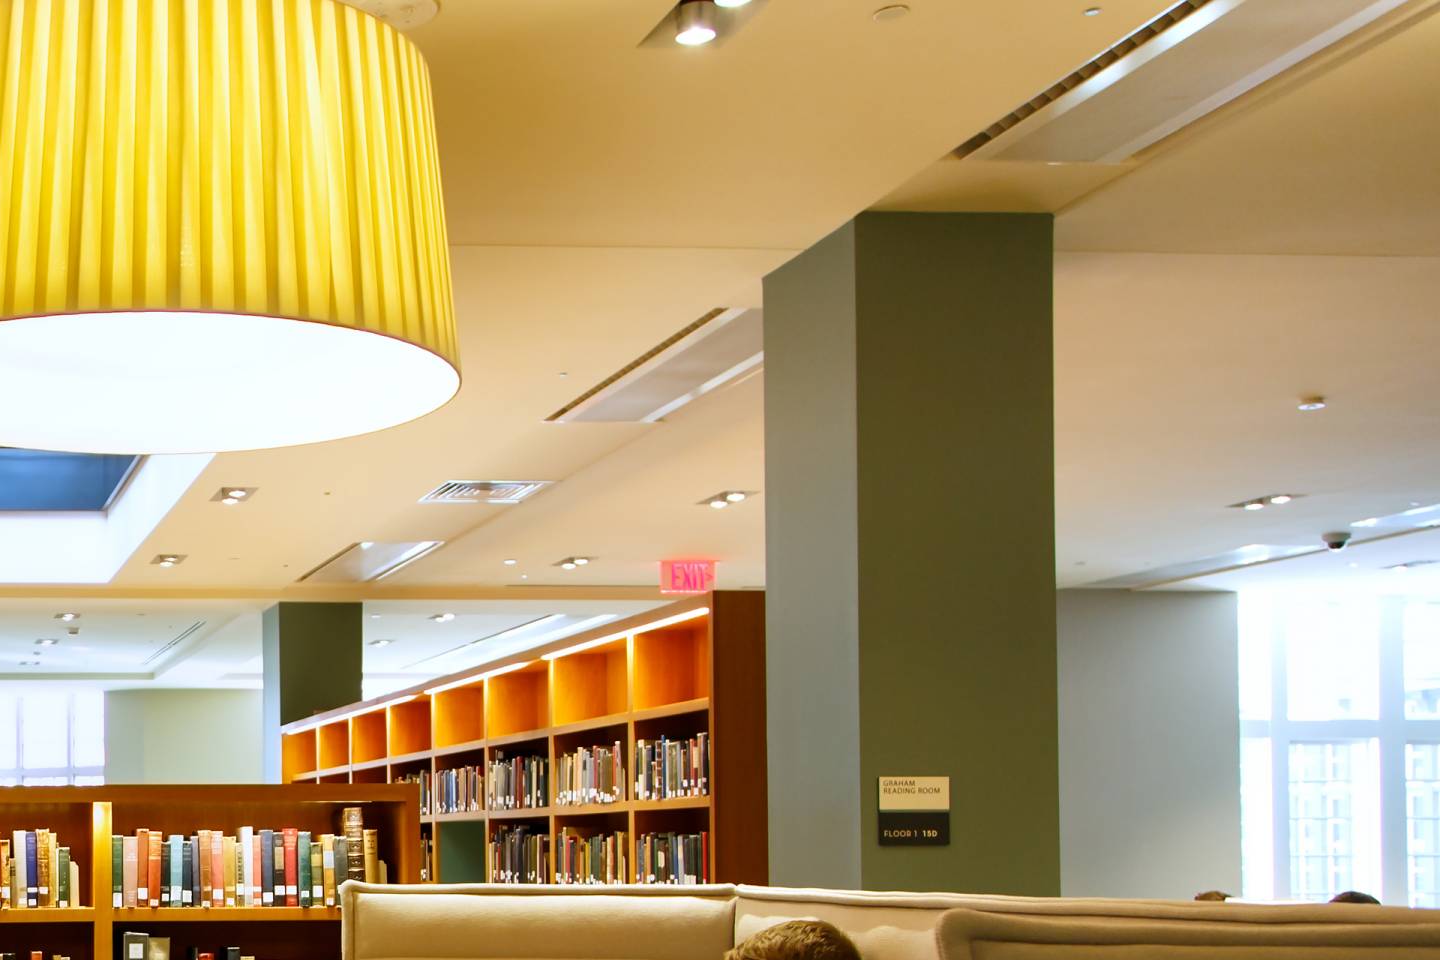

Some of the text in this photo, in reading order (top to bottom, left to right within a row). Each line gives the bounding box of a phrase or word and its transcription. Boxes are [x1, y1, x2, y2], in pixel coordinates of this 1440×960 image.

[671, 563, 708, 591] EXIT
[883, 787, 916, 795] READING
[883, 829, 912, 838] FLOOR
